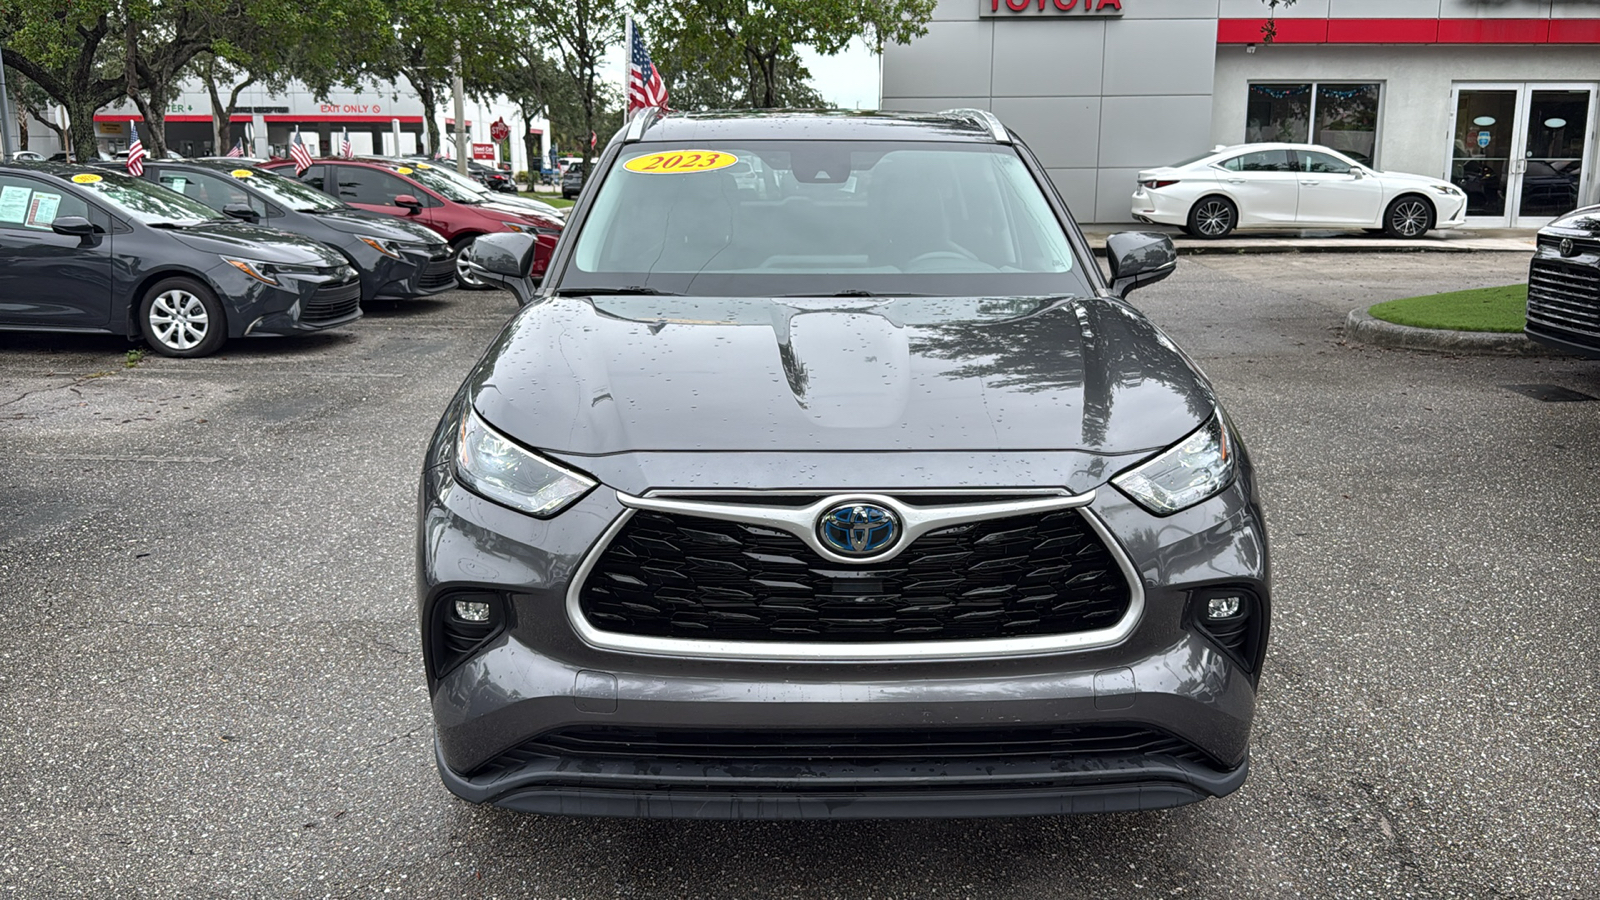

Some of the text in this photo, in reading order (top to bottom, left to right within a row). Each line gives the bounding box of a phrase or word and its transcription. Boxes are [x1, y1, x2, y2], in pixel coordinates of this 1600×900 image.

[320, 104, 369, 113] EXIT ONLY
[641, 153, 721, 170] 2023
